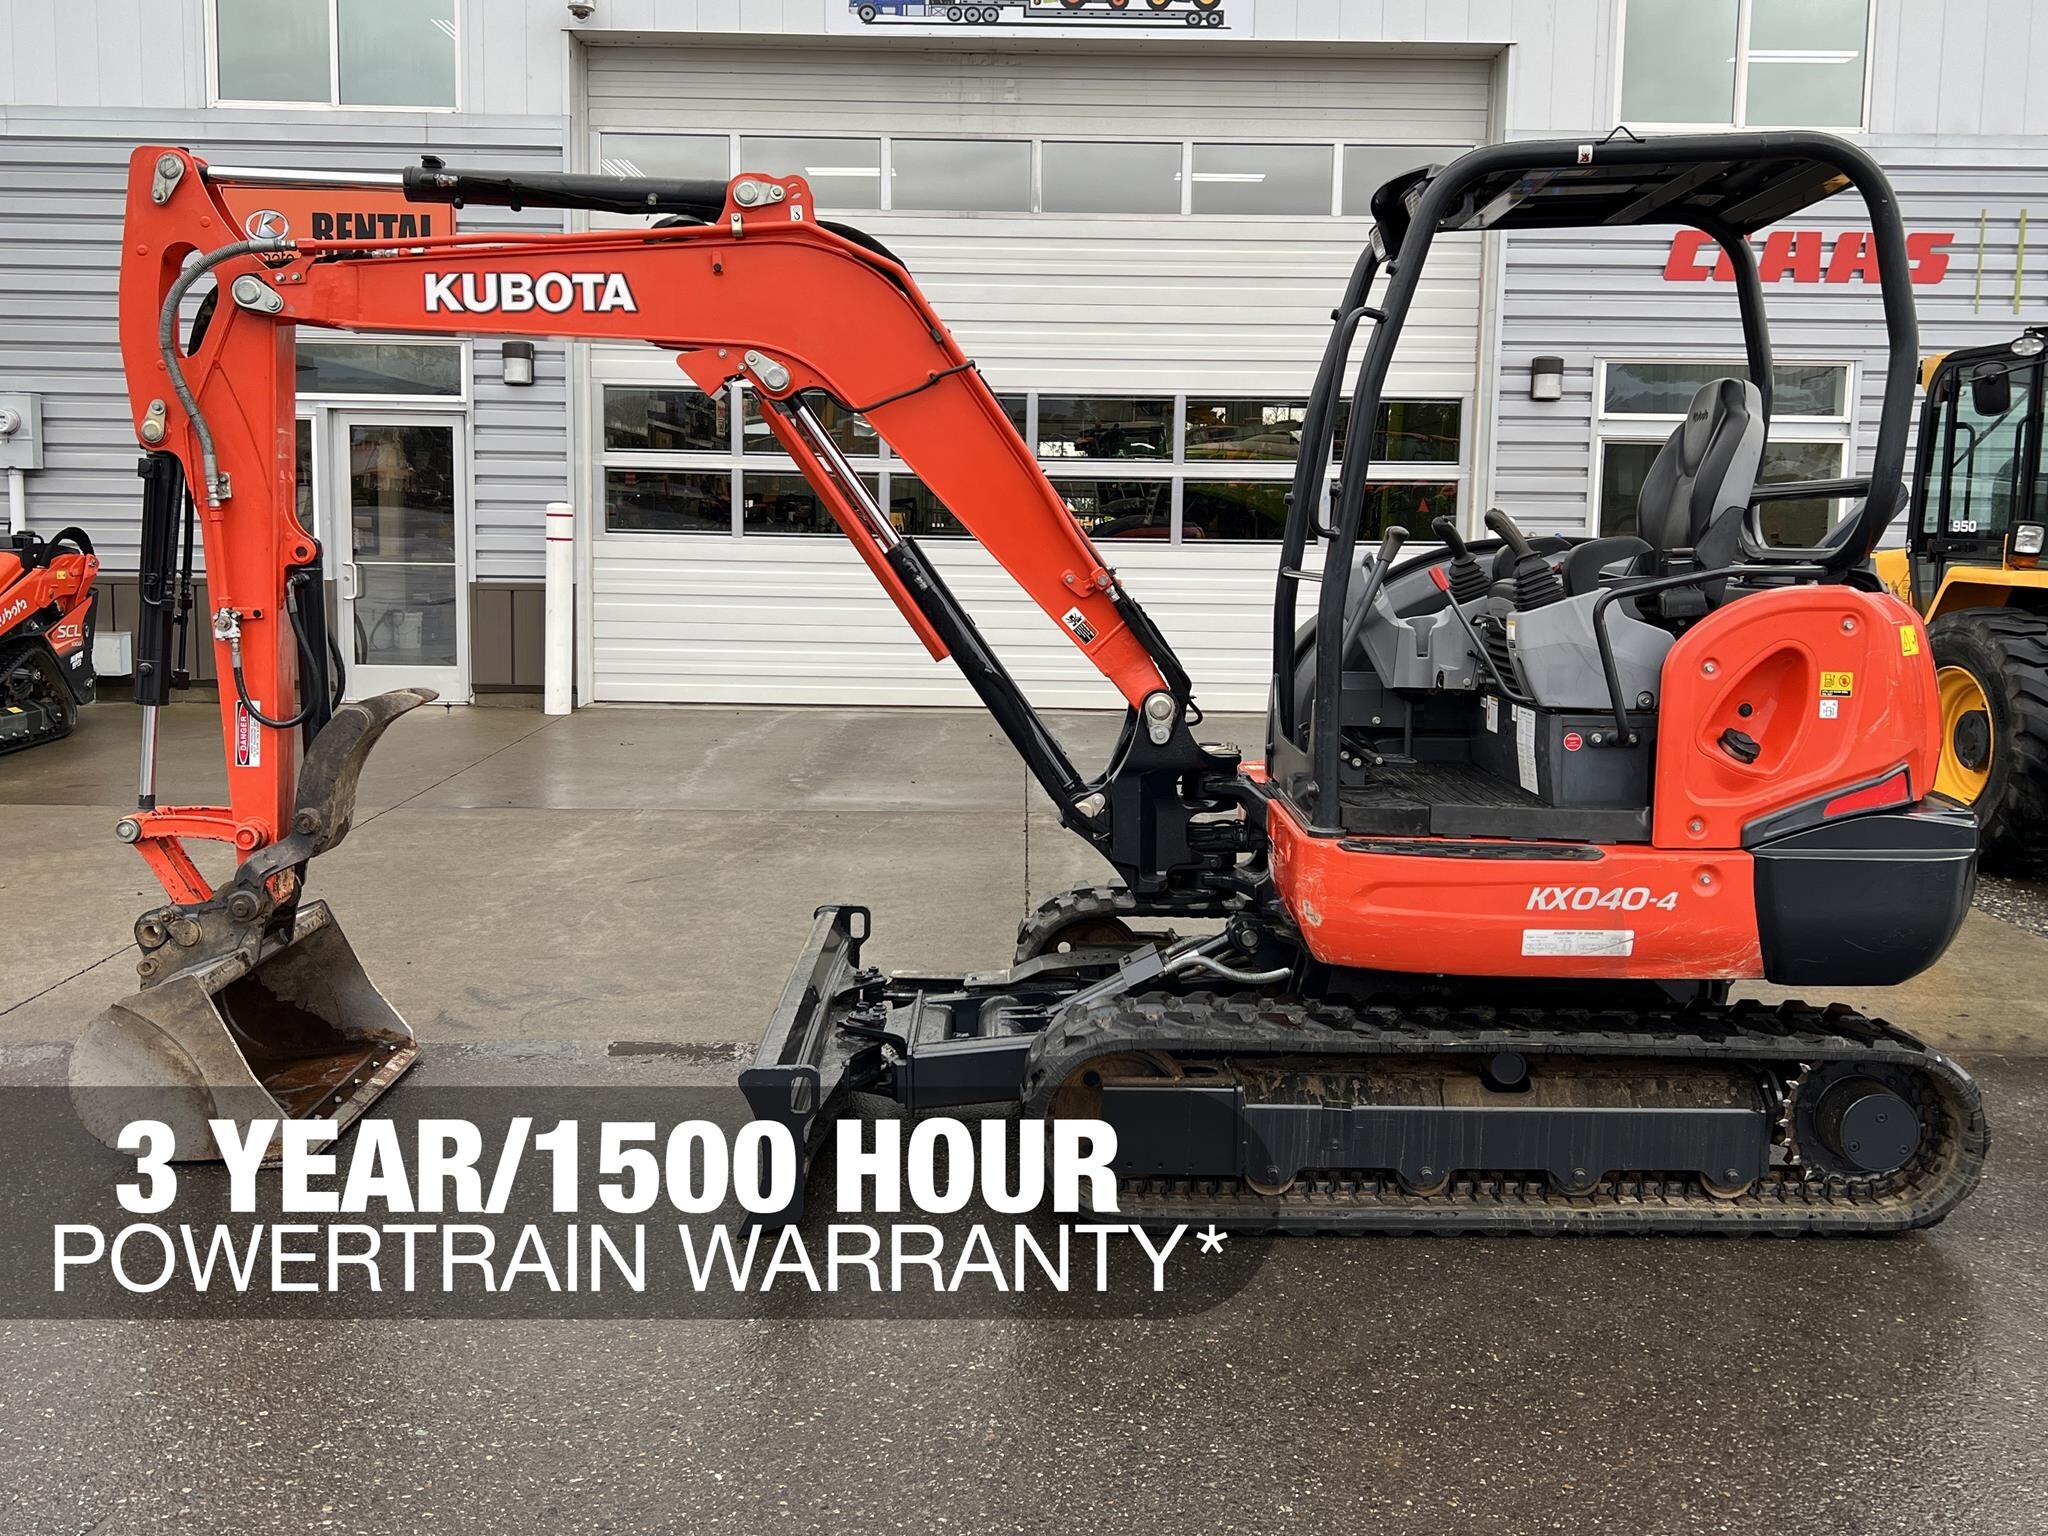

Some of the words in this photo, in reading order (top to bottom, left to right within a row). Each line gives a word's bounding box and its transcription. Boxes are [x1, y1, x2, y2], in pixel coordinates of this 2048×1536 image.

[424, 271, 639, 313] KUBOTA
[1952, 520, 1977, 533] 950
[0, 599, 28, 627] ubota
[57, 624, 82, 638] SCL
[240, 716, 248, 751] DANGER
[1526, 886, 1679, 911] KX040-4
